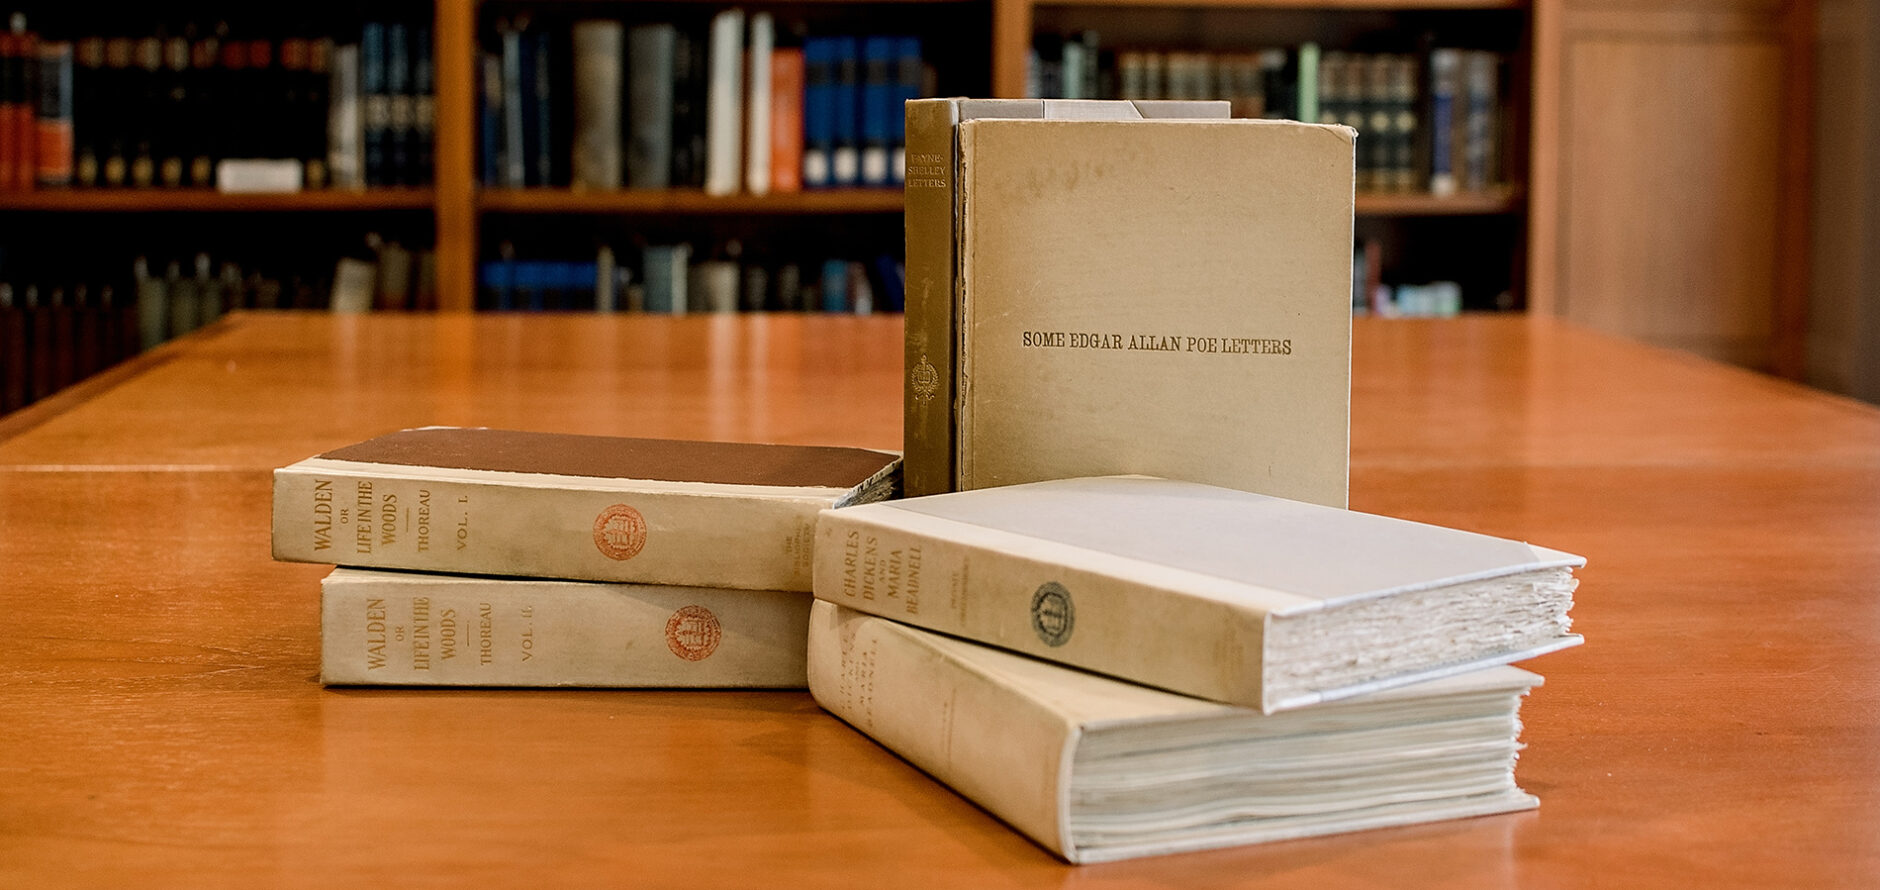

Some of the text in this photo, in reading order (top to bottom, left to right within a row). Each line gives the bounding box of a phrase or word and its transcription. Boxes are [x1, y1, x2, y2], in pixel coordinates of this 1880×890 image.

[908, 166, 946, 176] SHELLEY
[908, 178, 947, 188] LETTERS
[1023, 331, 1291, 355] SOME EDGAR ALLAN POE LETTERS
[358, 480, 373, 507] THE
[314, 479, 333, 551] WALDEN
[340, 508, 349, 525] OR
[381, 493, 398, 547] WOODS
[418, 489, 431, 552] THOREAU
[456, 511, 468, 551] VOL.
[357, 525, 372, 554] LIFE
[843, 530, 860, 598] CHARLES
[863, 536, 878, 601] DICKENS
[879, 559, 888, 584] AND
[888, 549, 903, 599] MARIA
[906, 544, 922, 615] BEADNELL
[367, 598, 387, 670] WALDEN
[395, 625, 405, 642] OR
[440, 608, 457, 661] WOODS
[480, 602, 492, 666] THOREAU
[521, 622, 533, 662] VOL.
[413, 640, 430, 671] LIFE
